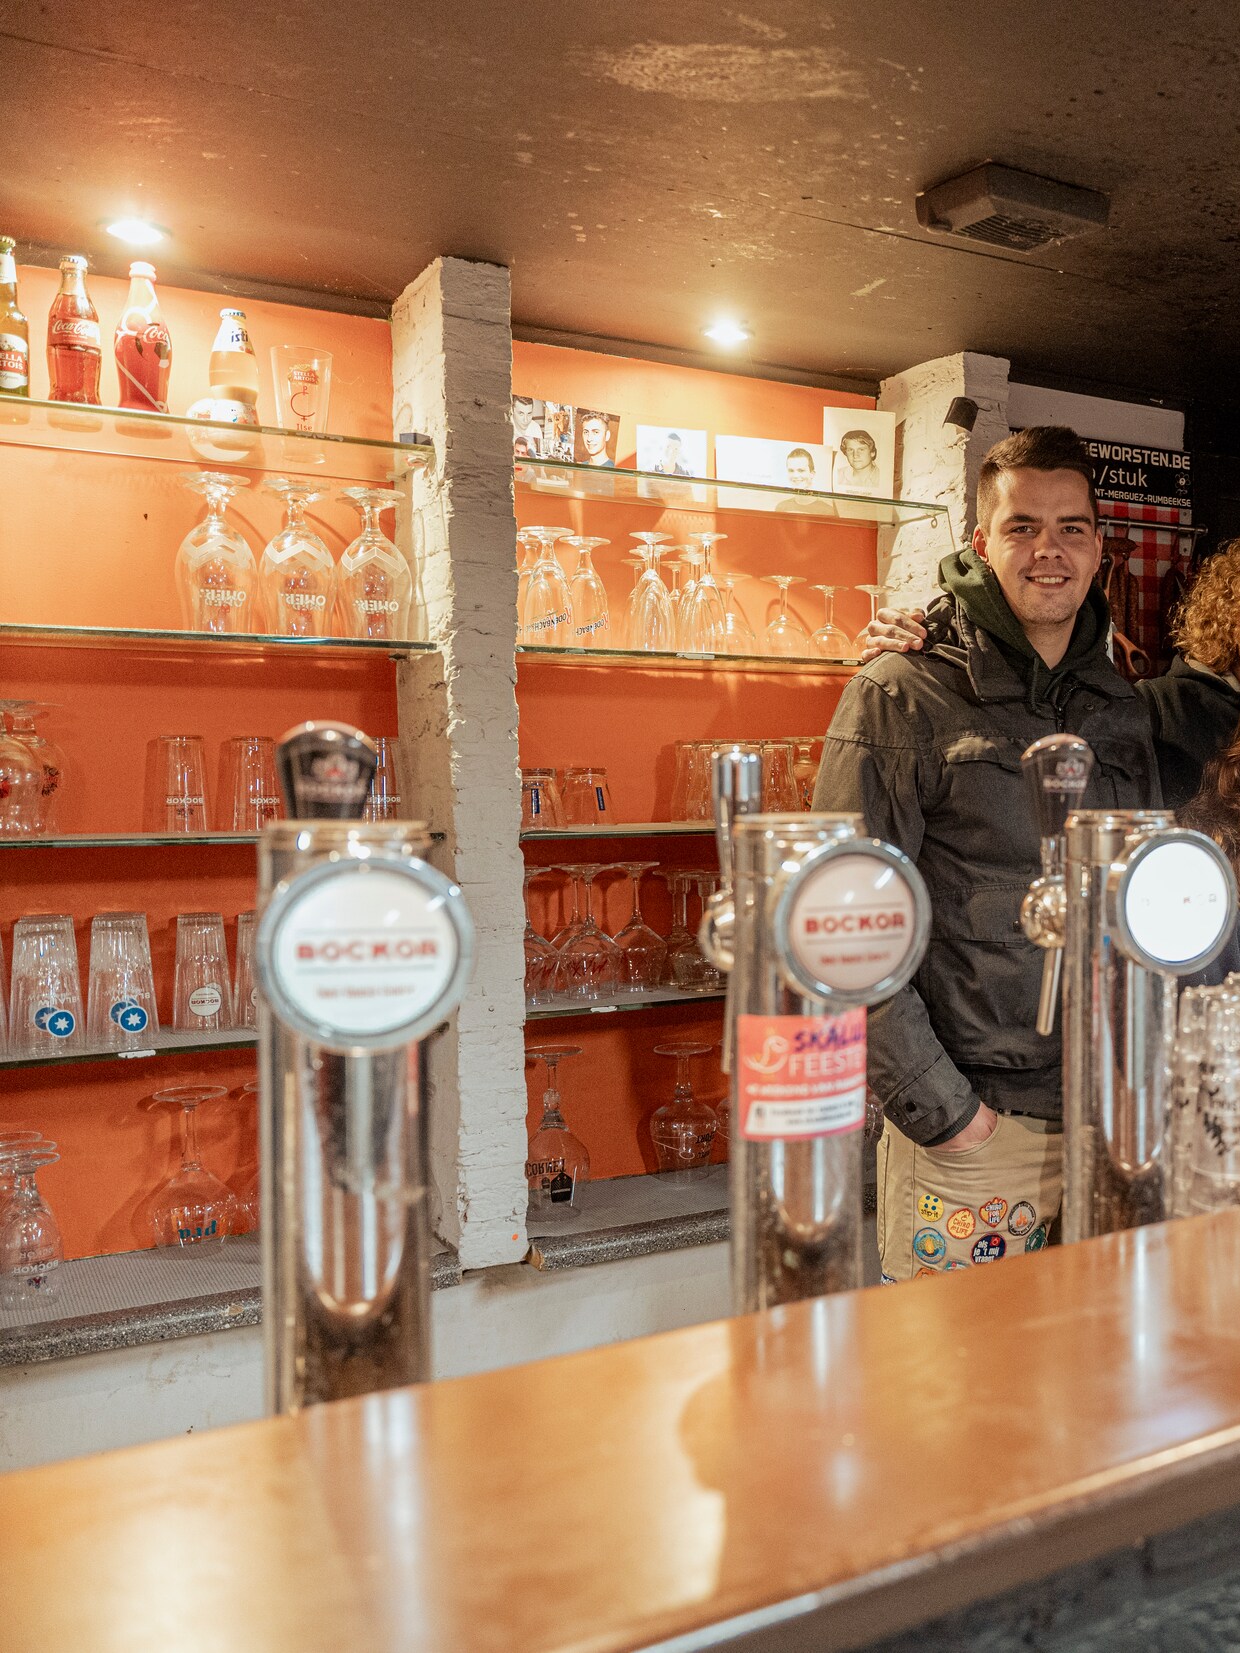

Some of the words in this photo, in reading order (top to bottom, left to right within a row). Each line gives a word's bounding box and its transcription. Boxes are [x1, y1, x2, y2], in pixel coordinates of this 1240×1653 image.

[296, 423, 313, 431] Ilse
[166, 796, 204, 804] BOCKOR
[804, 913, 905, 934] BOCKOR
[296, 939, 438, 961] BOCKOR
[191, 998, 220, 1006] BOCKOR
[13, 1260, 59, 1275] BOCKOR
